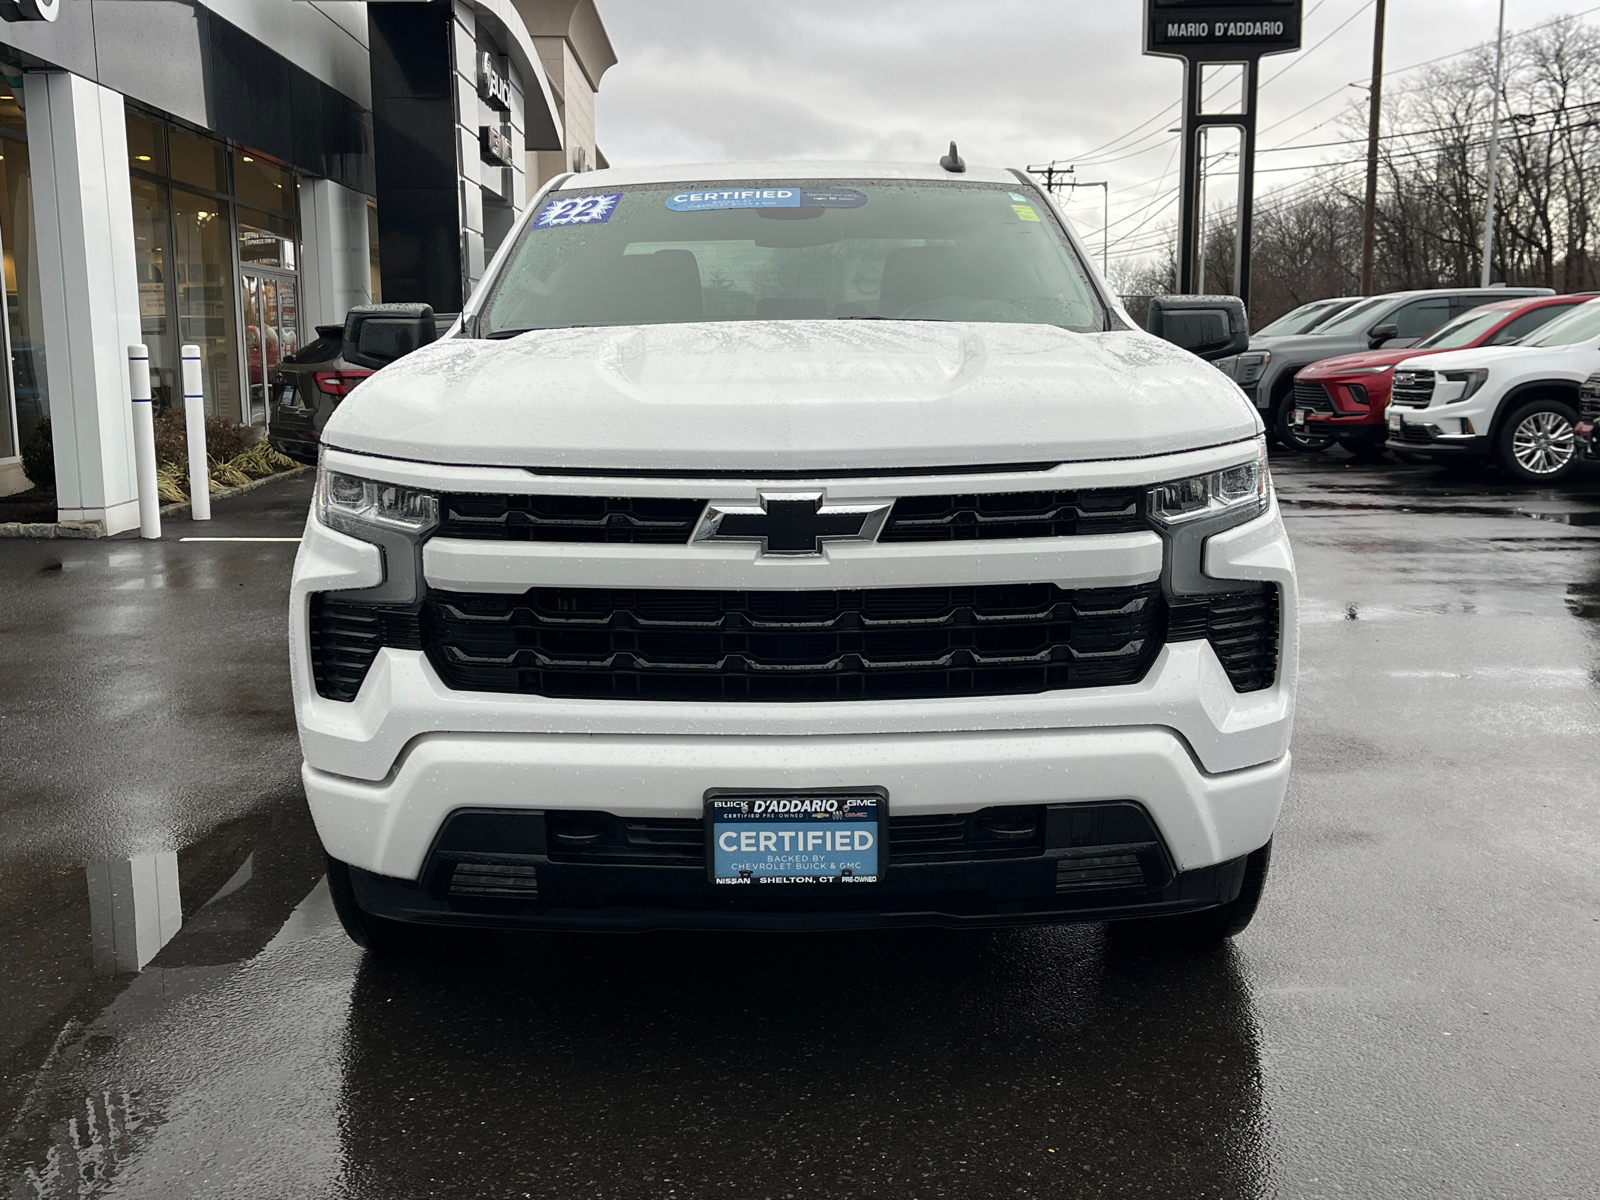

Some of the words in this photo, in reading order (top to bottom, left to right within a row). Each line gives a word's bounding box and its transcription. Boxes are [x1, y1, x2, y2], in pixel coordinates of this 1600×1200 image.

[1167, 23, 1209, 37] MARIO
[1214, 21, 1284, 36] D'ADDARIO
[673, 190, 793, 203] CERTIFIED
[552, 199, 600, 220] 22
[753, 800, 838, 813] D'ADDARIO
[718, 830, 874, 852] CERTIFIED
[759, 876, 816, 884] SHELTON,
